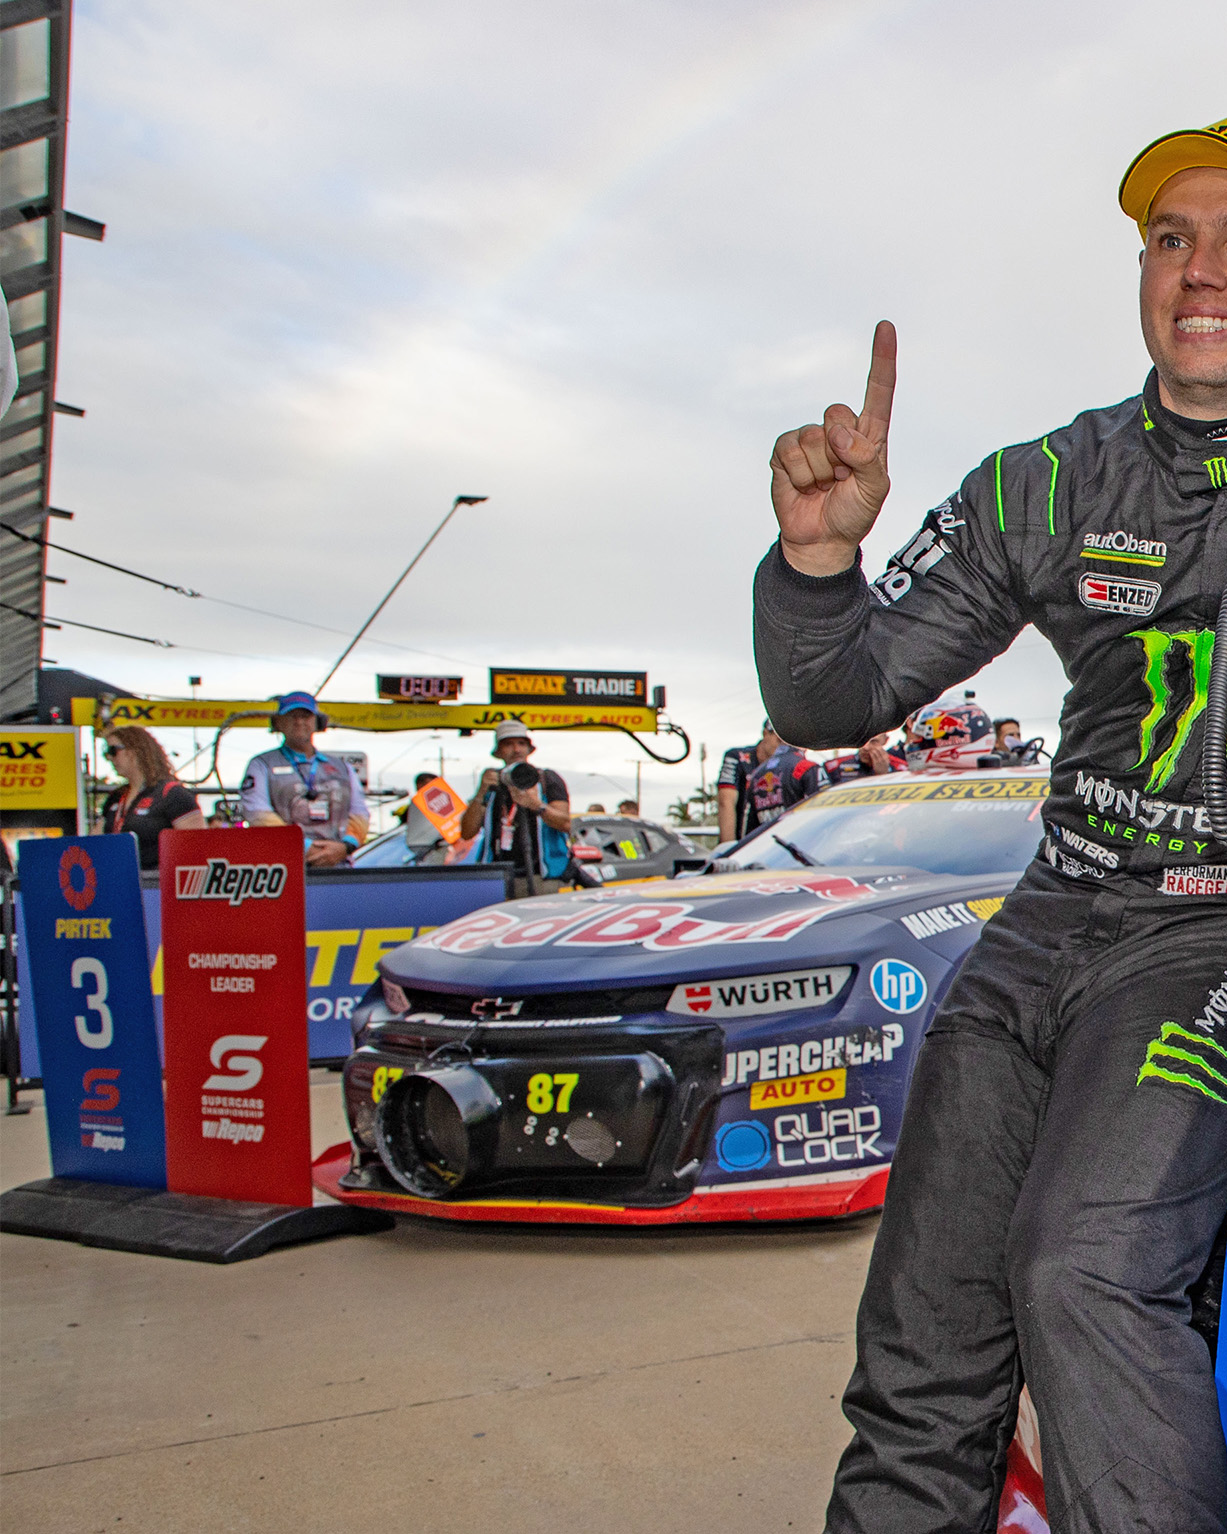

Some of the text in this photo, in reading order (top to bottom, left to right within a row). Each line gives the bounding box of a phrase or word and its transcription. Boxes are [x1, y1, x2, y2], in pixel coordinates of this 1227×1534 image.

[1108, 584, 1154, 607] ENZED
[573, 677, 635, 697] TRADIE
[112, 705, 225, 721] AX TYRES
[474, 711, 527, 724] JAX
[529, 713, 582, 725] TYRES
[599, 714, 644, 726] AUTO
[0, 741, 47, 759] AX
[0, 763, 47, 774] RES
[0, 777, 46, 787] UTO
[950, 800, 1034, 812] Brown
[1087, 814, 1208, 855] ENERGY
[1060, 826, 1120, 869] WATERS
[204, 859, 286, 904] Repco
[55, 918, 112, 939] PIRTEK
[900, 901, 979, 941] MAKE IT
[188, 953, 278, 970] CHAMPIONSHIP
[210, 977, 255, 993] LEADER
[882, 969, 916, 1014] hp
[71, 956, 114, 1050] 3
[526, 1072, 580, 1114] 87
[760, 1077, 836, 1101] AUTO
[201, 1095, 264, 1110] SUPERCARS
[215, 1117, 265, 1144] Repco
[774, 1105, 882, 1144] QUAD
[777, 1131, 884, 1167] LOCK
